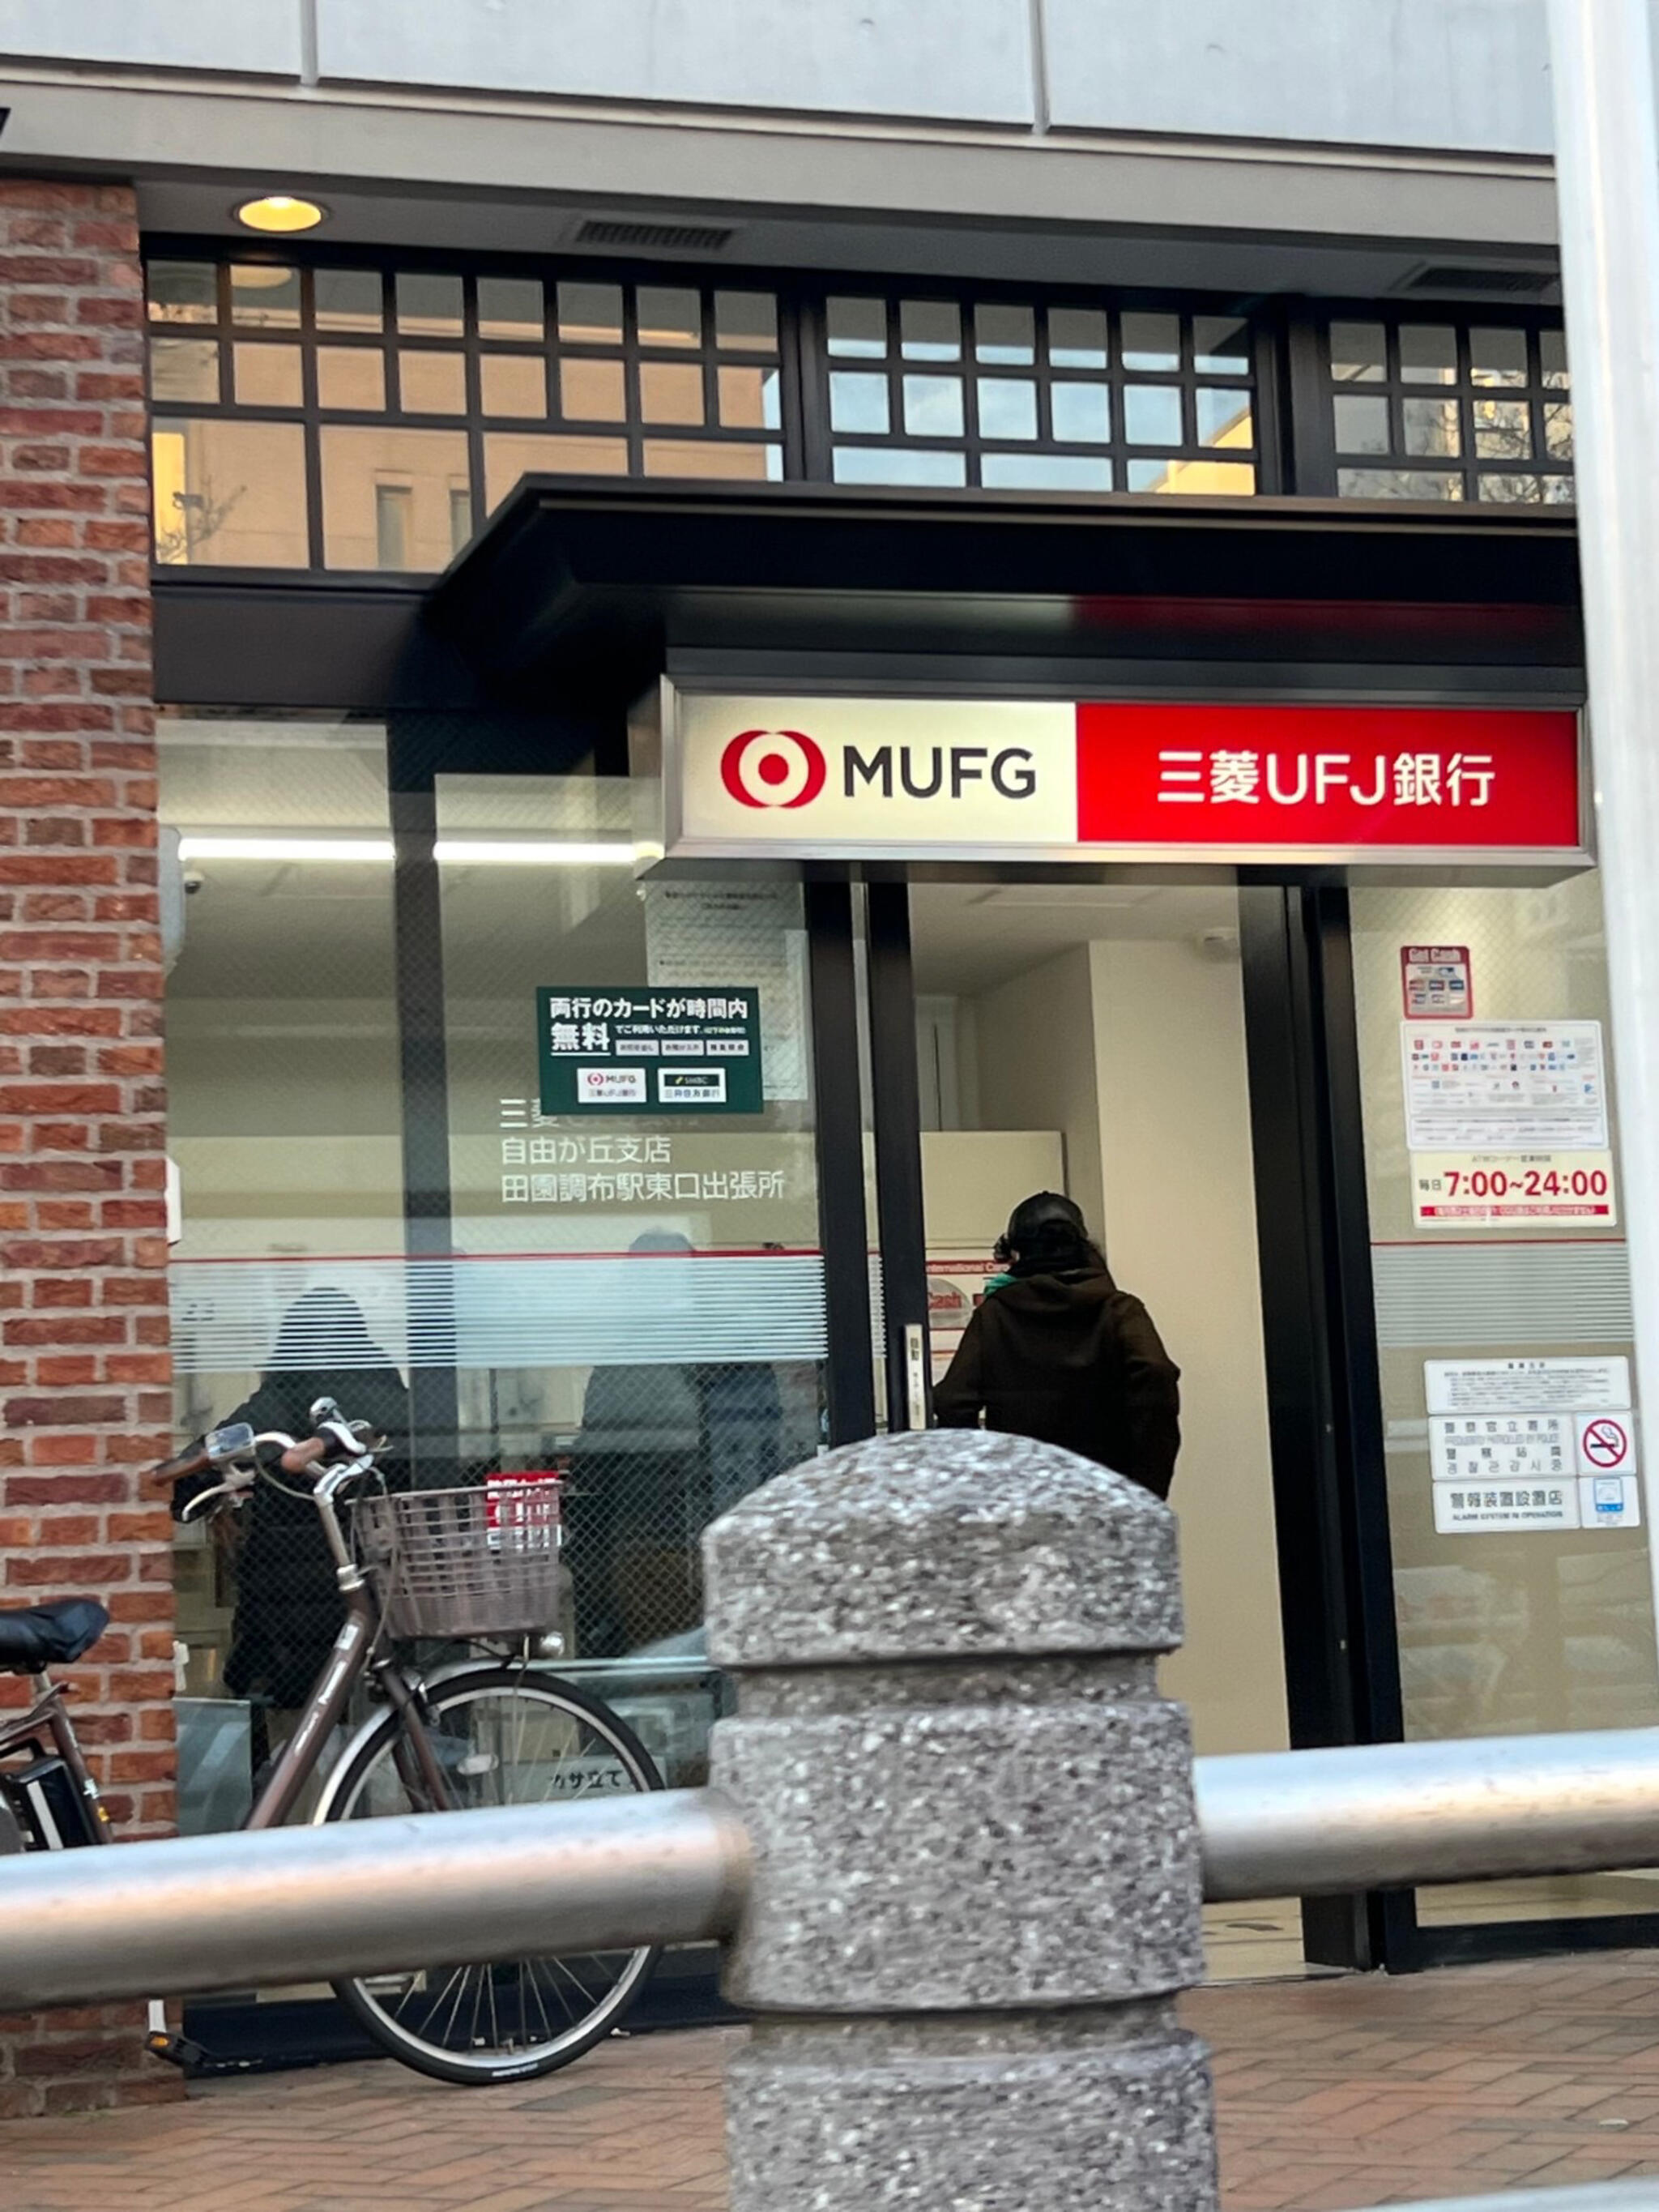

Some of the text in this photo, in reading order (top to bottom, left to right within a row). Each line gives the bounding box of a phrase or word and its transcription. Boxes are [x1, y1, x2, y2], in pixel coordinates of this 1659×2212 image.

[842, 745, 1036, 800] MUFG
[1158, 749, 1496, 807] 三菱UFJ銀行
[549, 997, 748, 1018] 両行のカードが時間内
[551, 1023, 611, 1051] 無料
[501, 1136, 672, 1164] 自由が丘支店
[501, 1170, 785, 1202] 田園調布駅東口出張所
[1419, 1179, 1442, 1191] 毎日
